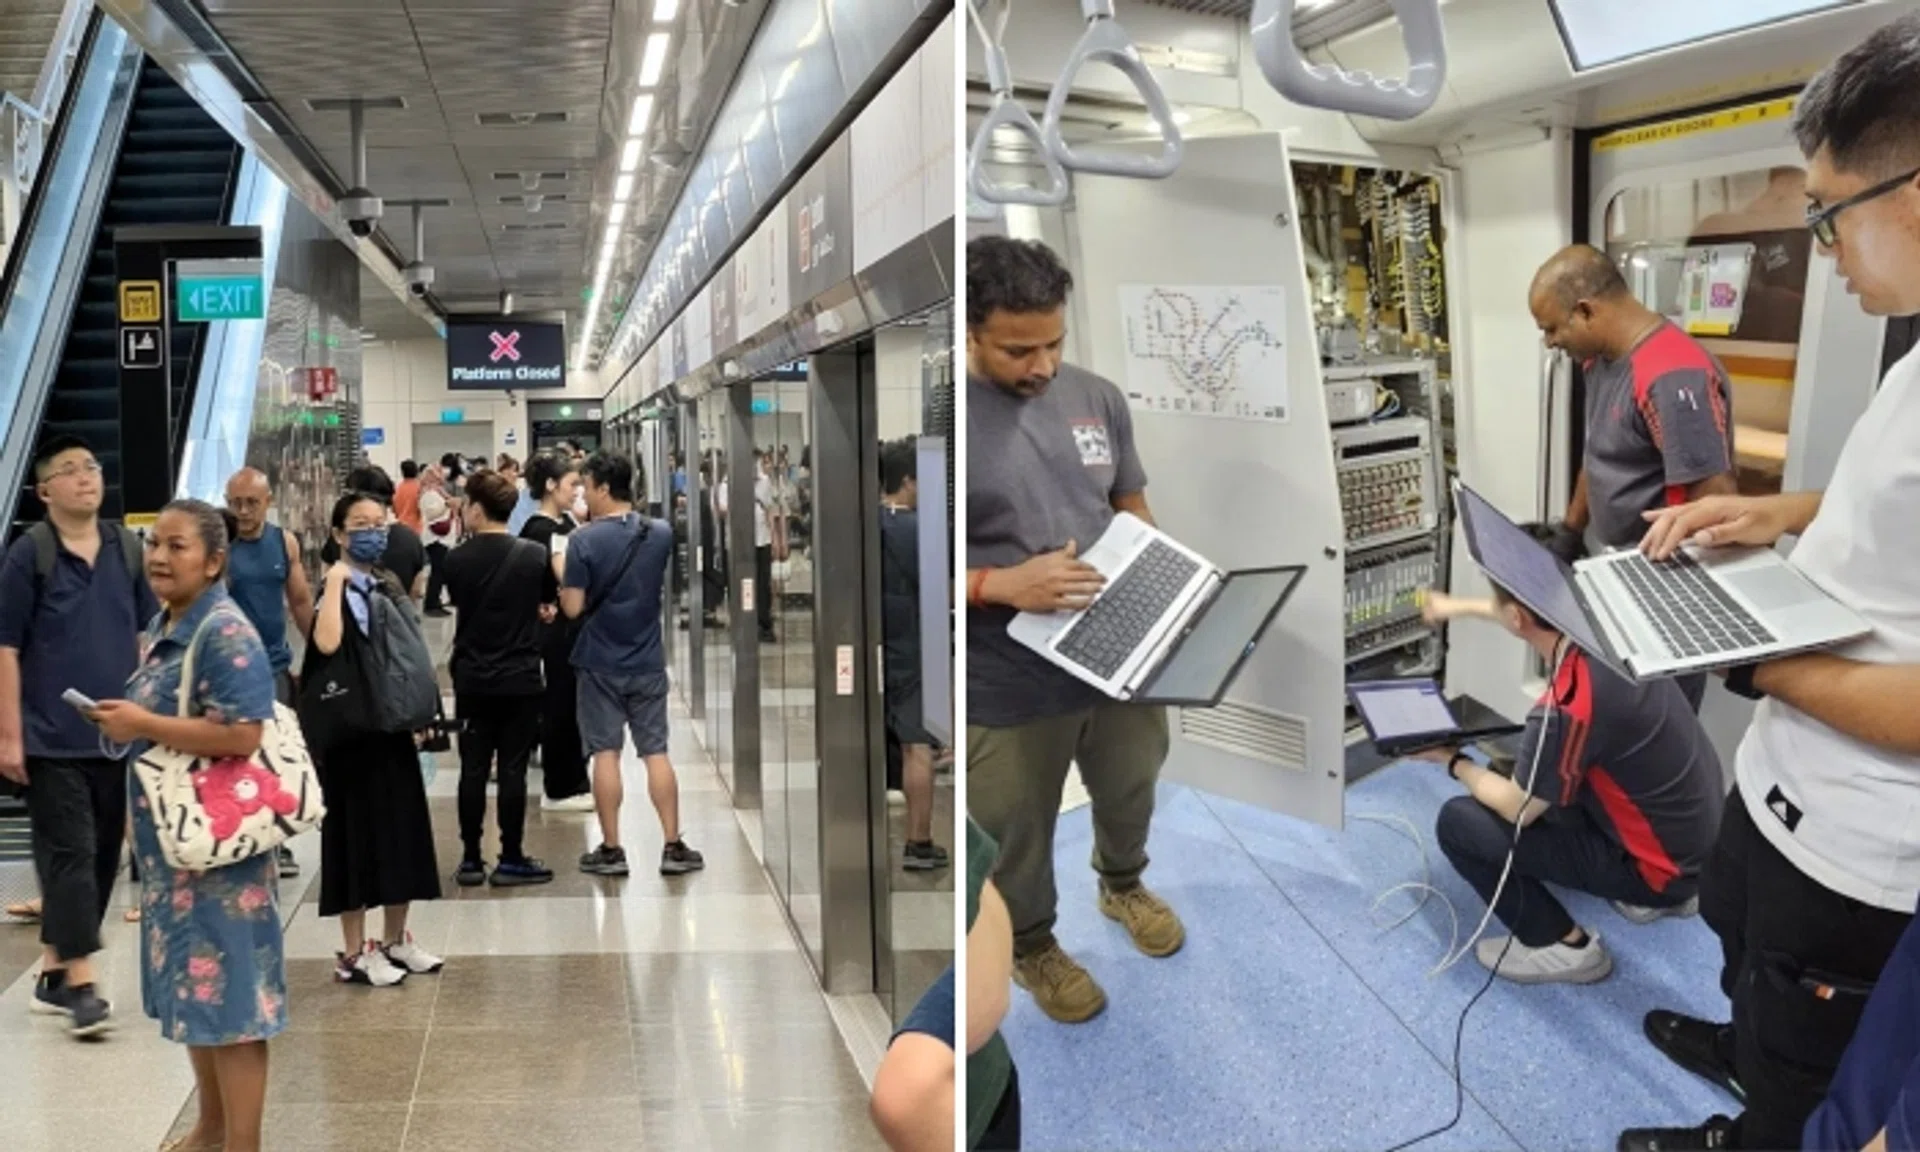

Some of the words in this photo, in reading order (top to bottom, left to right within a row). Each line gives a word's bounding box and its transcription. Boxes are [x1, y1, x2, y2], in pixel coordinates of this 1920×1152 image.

[203, 285, 255, 313] EXIT
[452, 365, 513, 380] Platform
[515, 364, 561, 380] Closed
